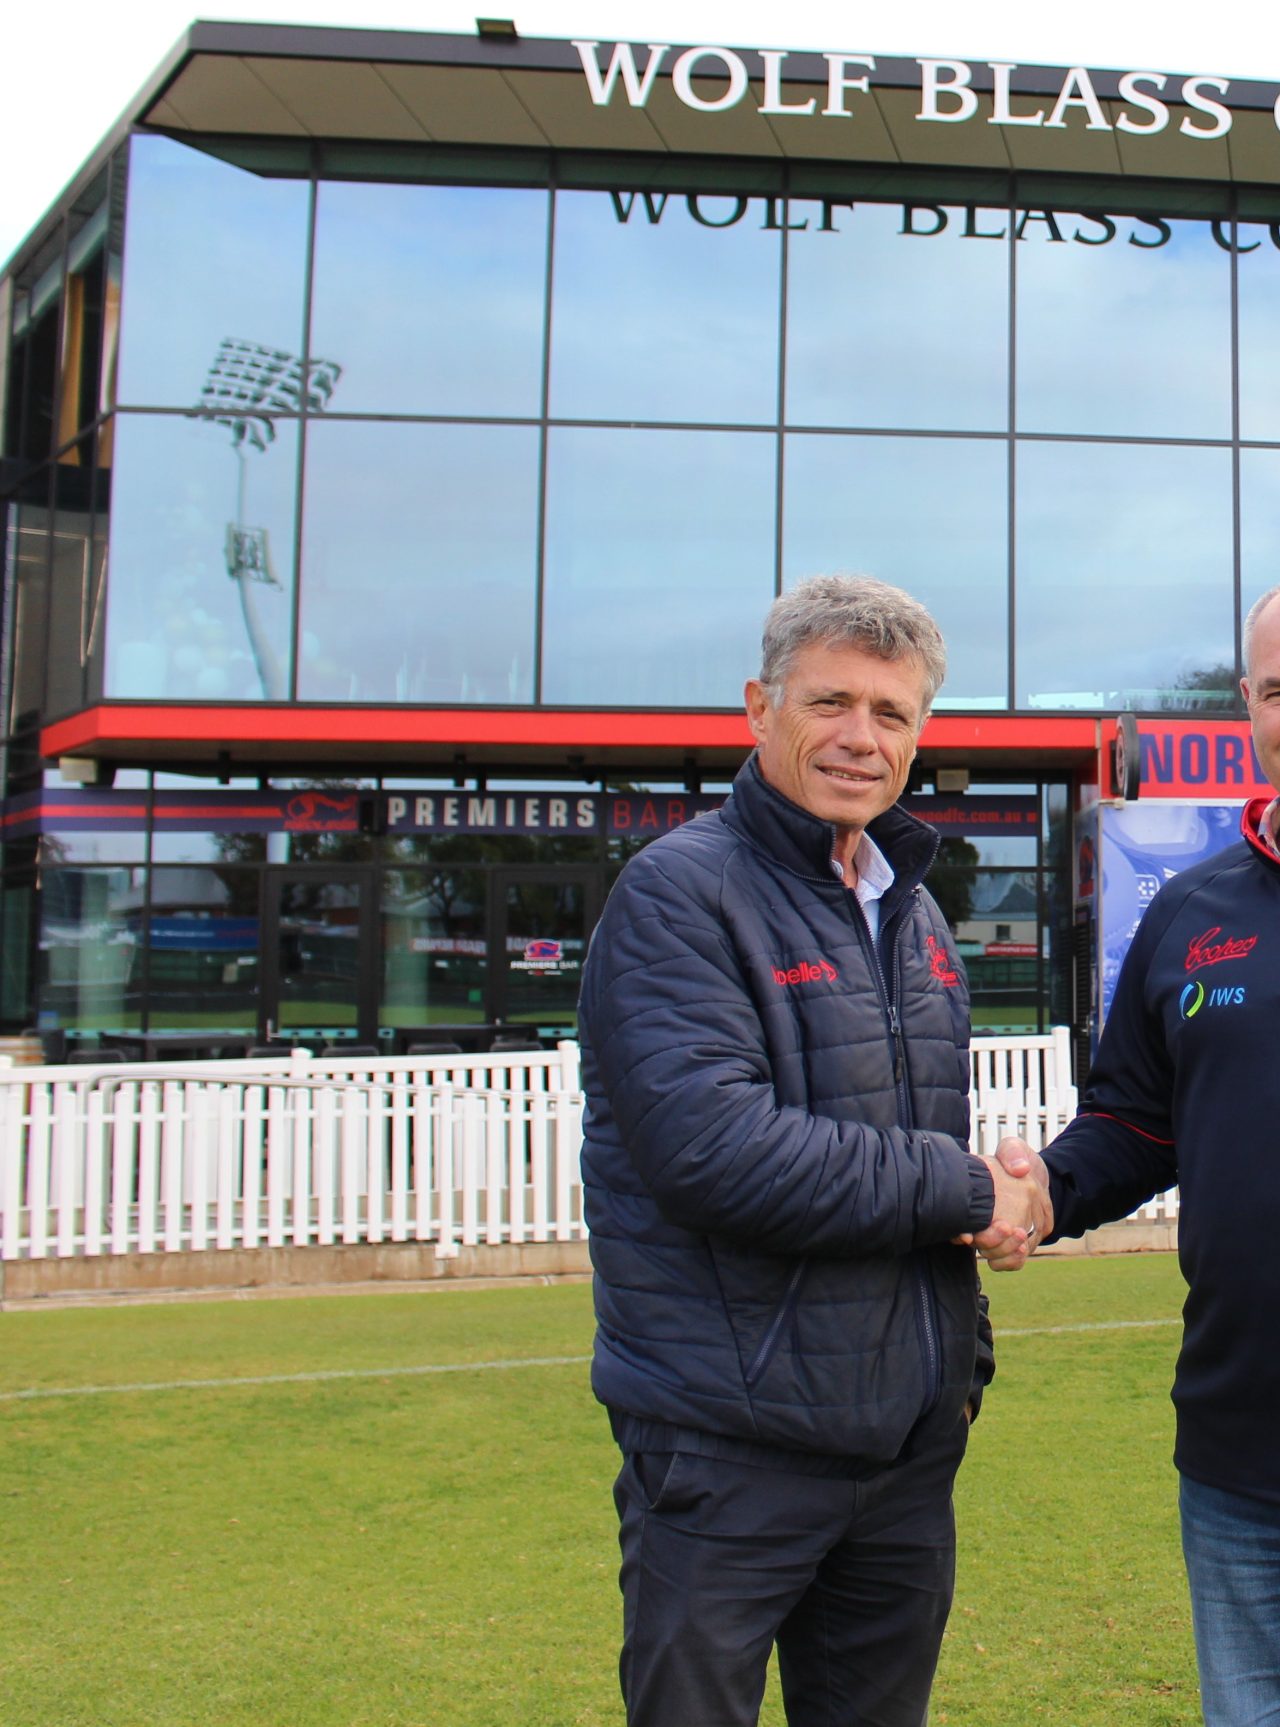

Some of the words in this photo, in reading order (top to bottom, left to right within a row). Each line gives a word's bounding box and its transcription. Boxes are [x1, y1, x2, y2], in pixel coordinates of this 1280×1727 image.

[571, 40, 877, 117] WOLF
[915, 57, 1234, 139] BLASS
[387, 796, 596, 829] PREMIERS
[613, 800, 686, 829] BAR
[1208, 986, 1246, 1007] IWS
